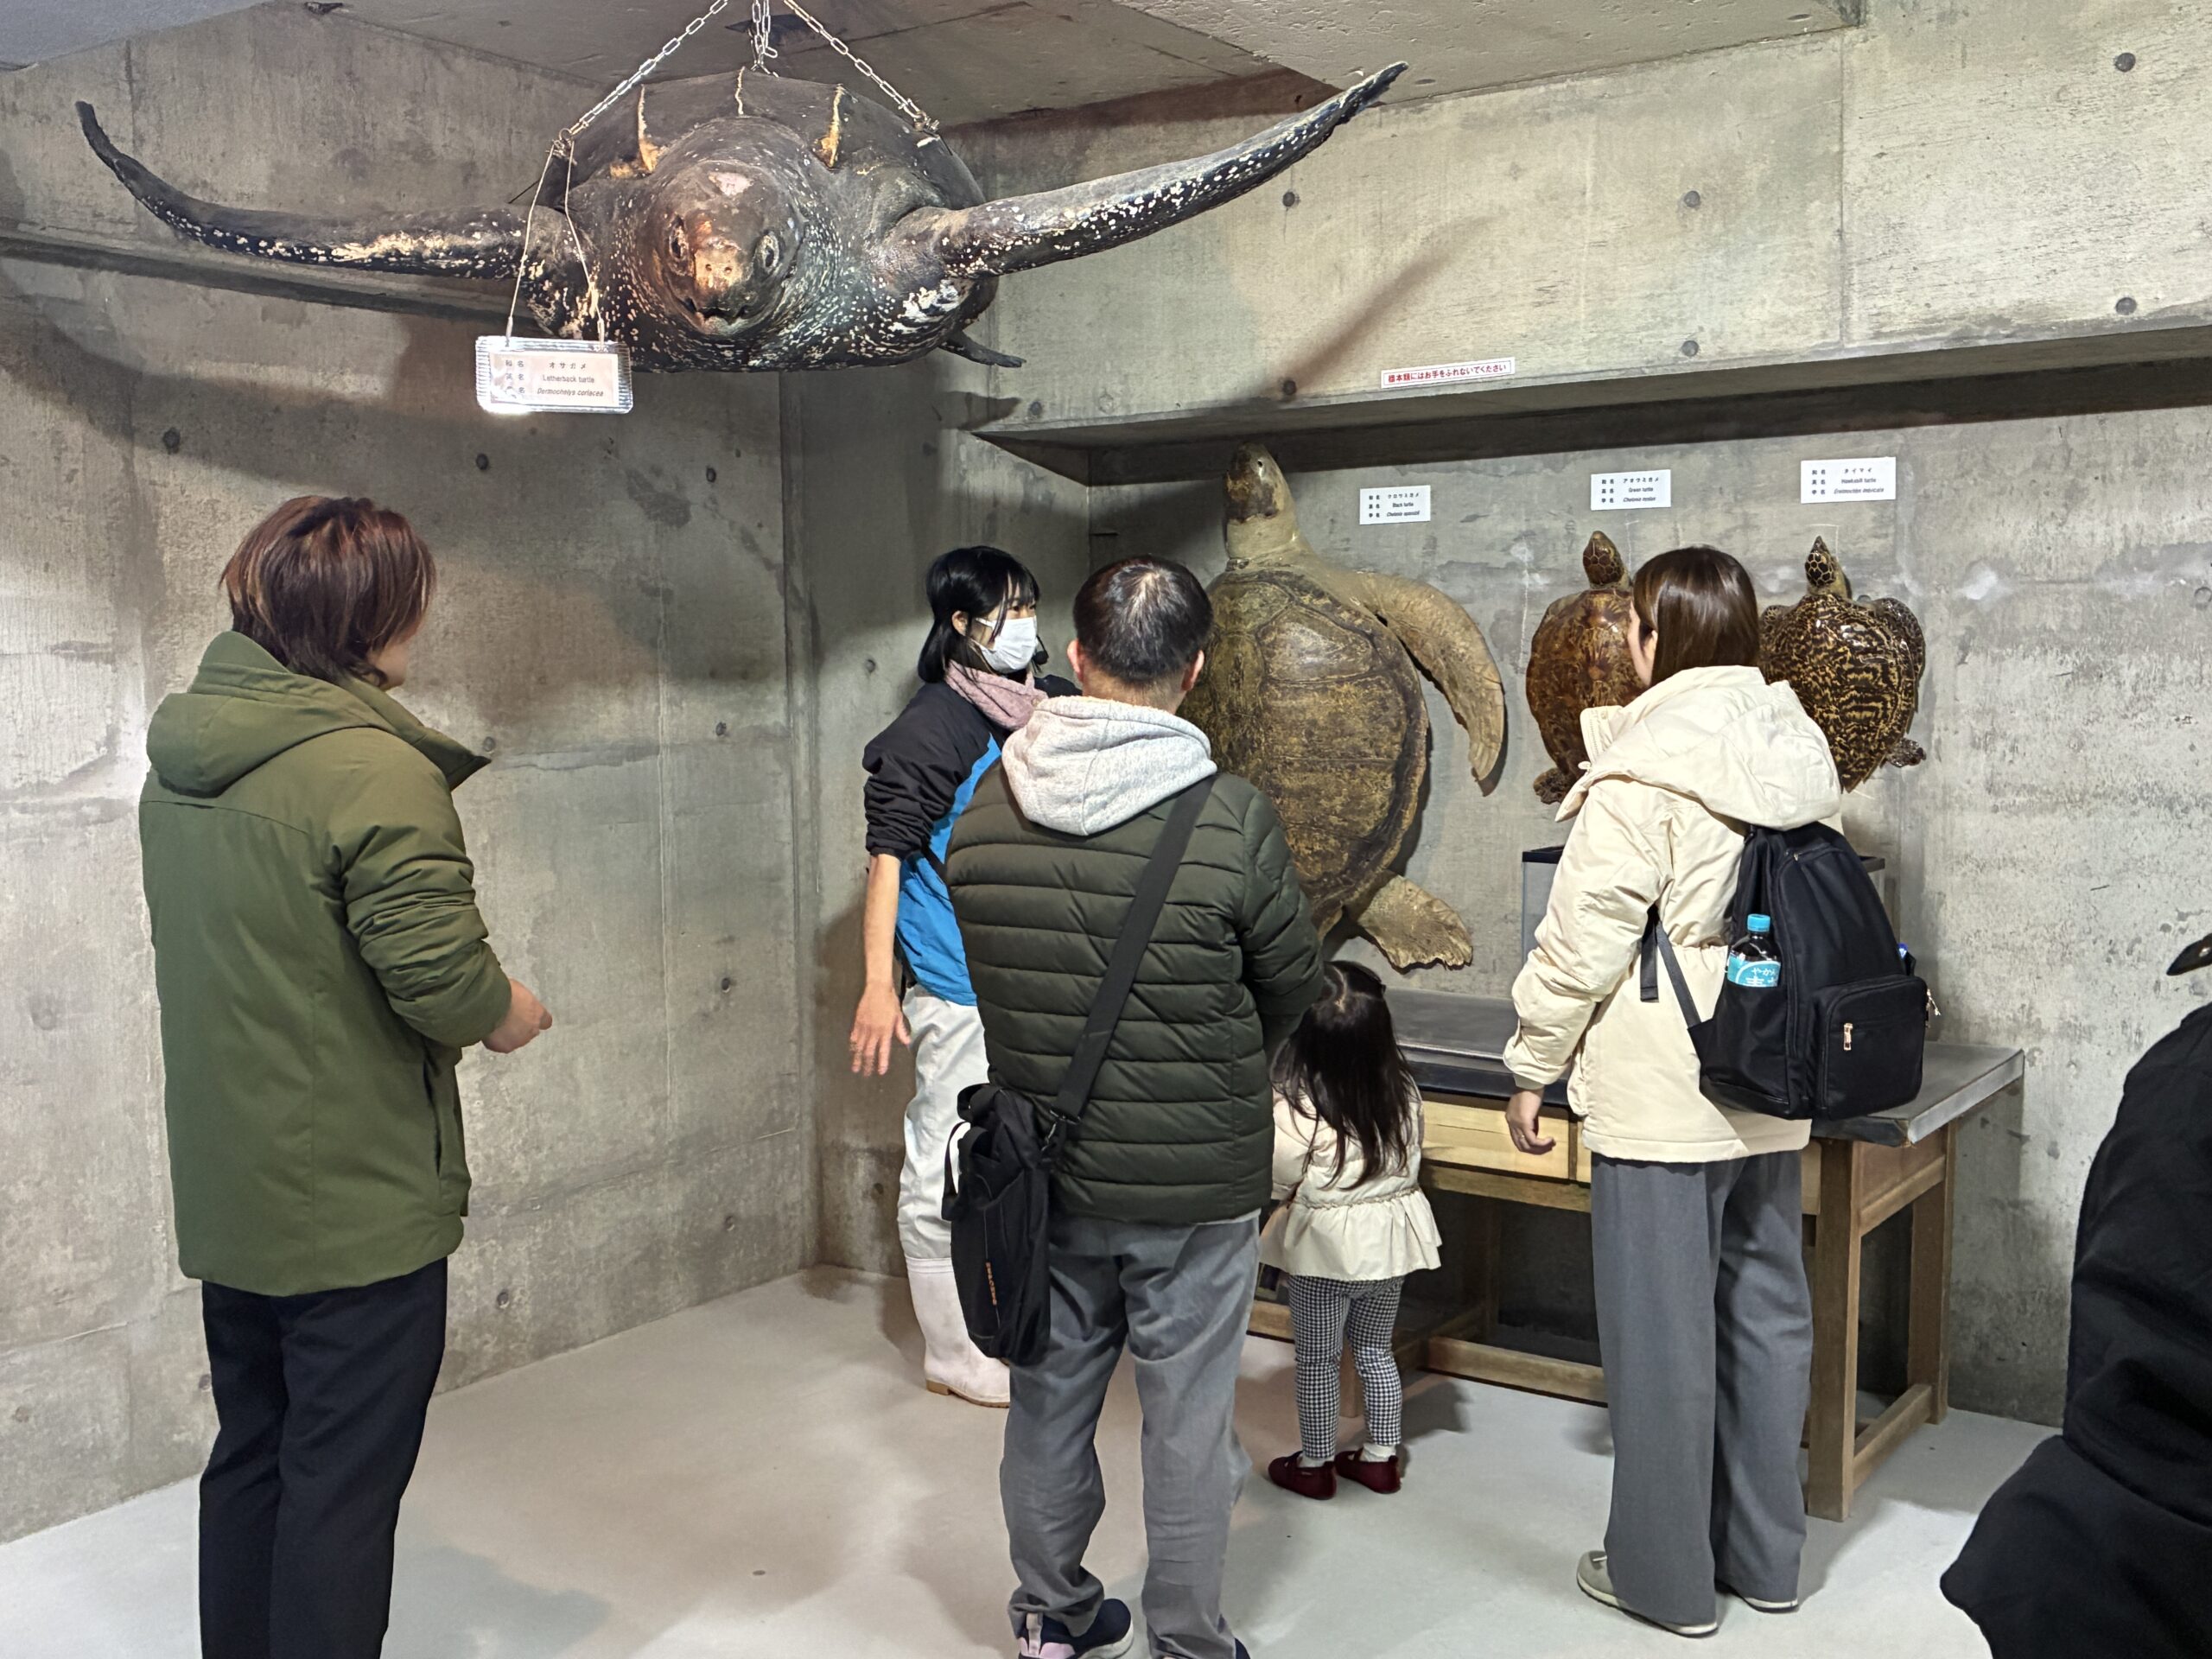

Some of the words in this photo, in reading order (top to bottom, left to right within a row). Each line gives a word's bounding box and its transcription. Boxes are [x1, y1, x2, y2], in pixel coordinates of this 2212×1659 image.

[1388, 364, 1507, 383] 標本類にはお手をふれないでください
